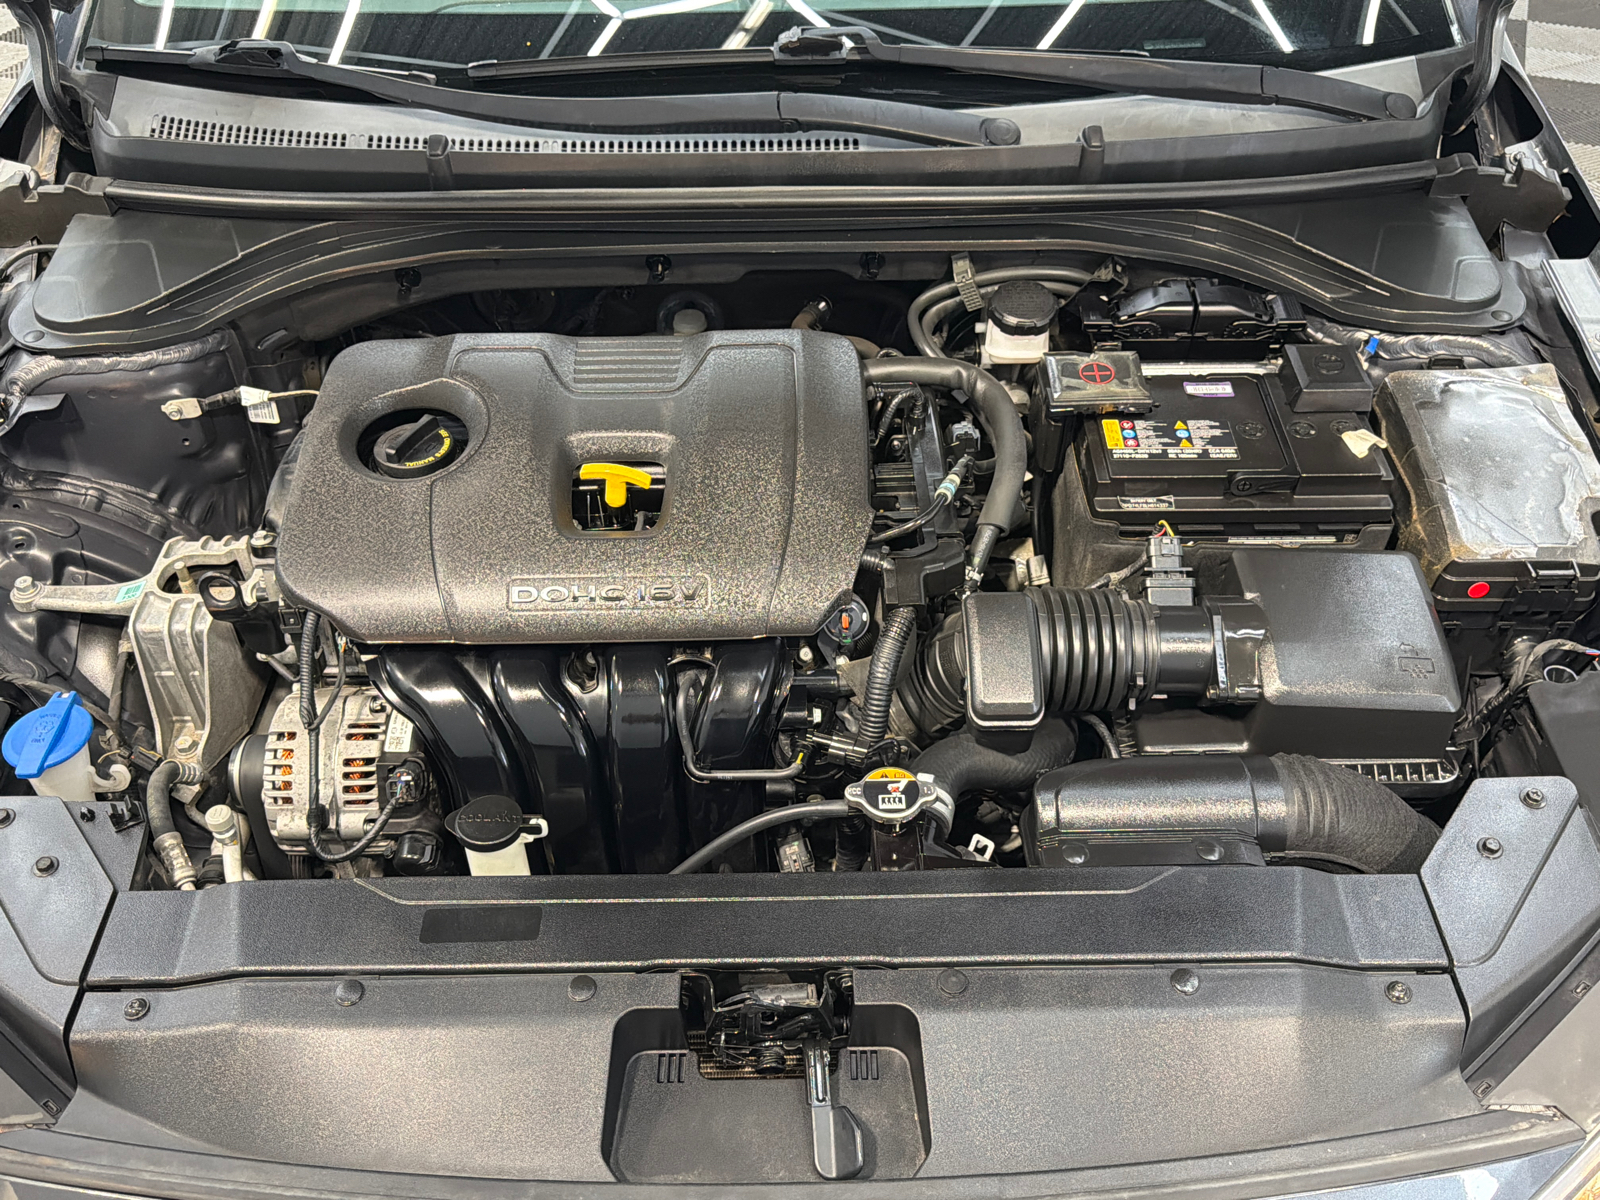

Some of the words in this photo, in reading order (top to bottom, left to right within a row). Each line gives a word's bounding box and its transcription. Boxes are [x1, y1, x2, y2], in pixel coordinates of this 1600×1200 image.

[438, 429, 449, 437] SEE
[405, 456, 436, 467] MANUAL
[511, 584, 626, 603] DOHC
[638, 582, 706, 602] 16V
[458, 810, 521, 824] COOLANT
